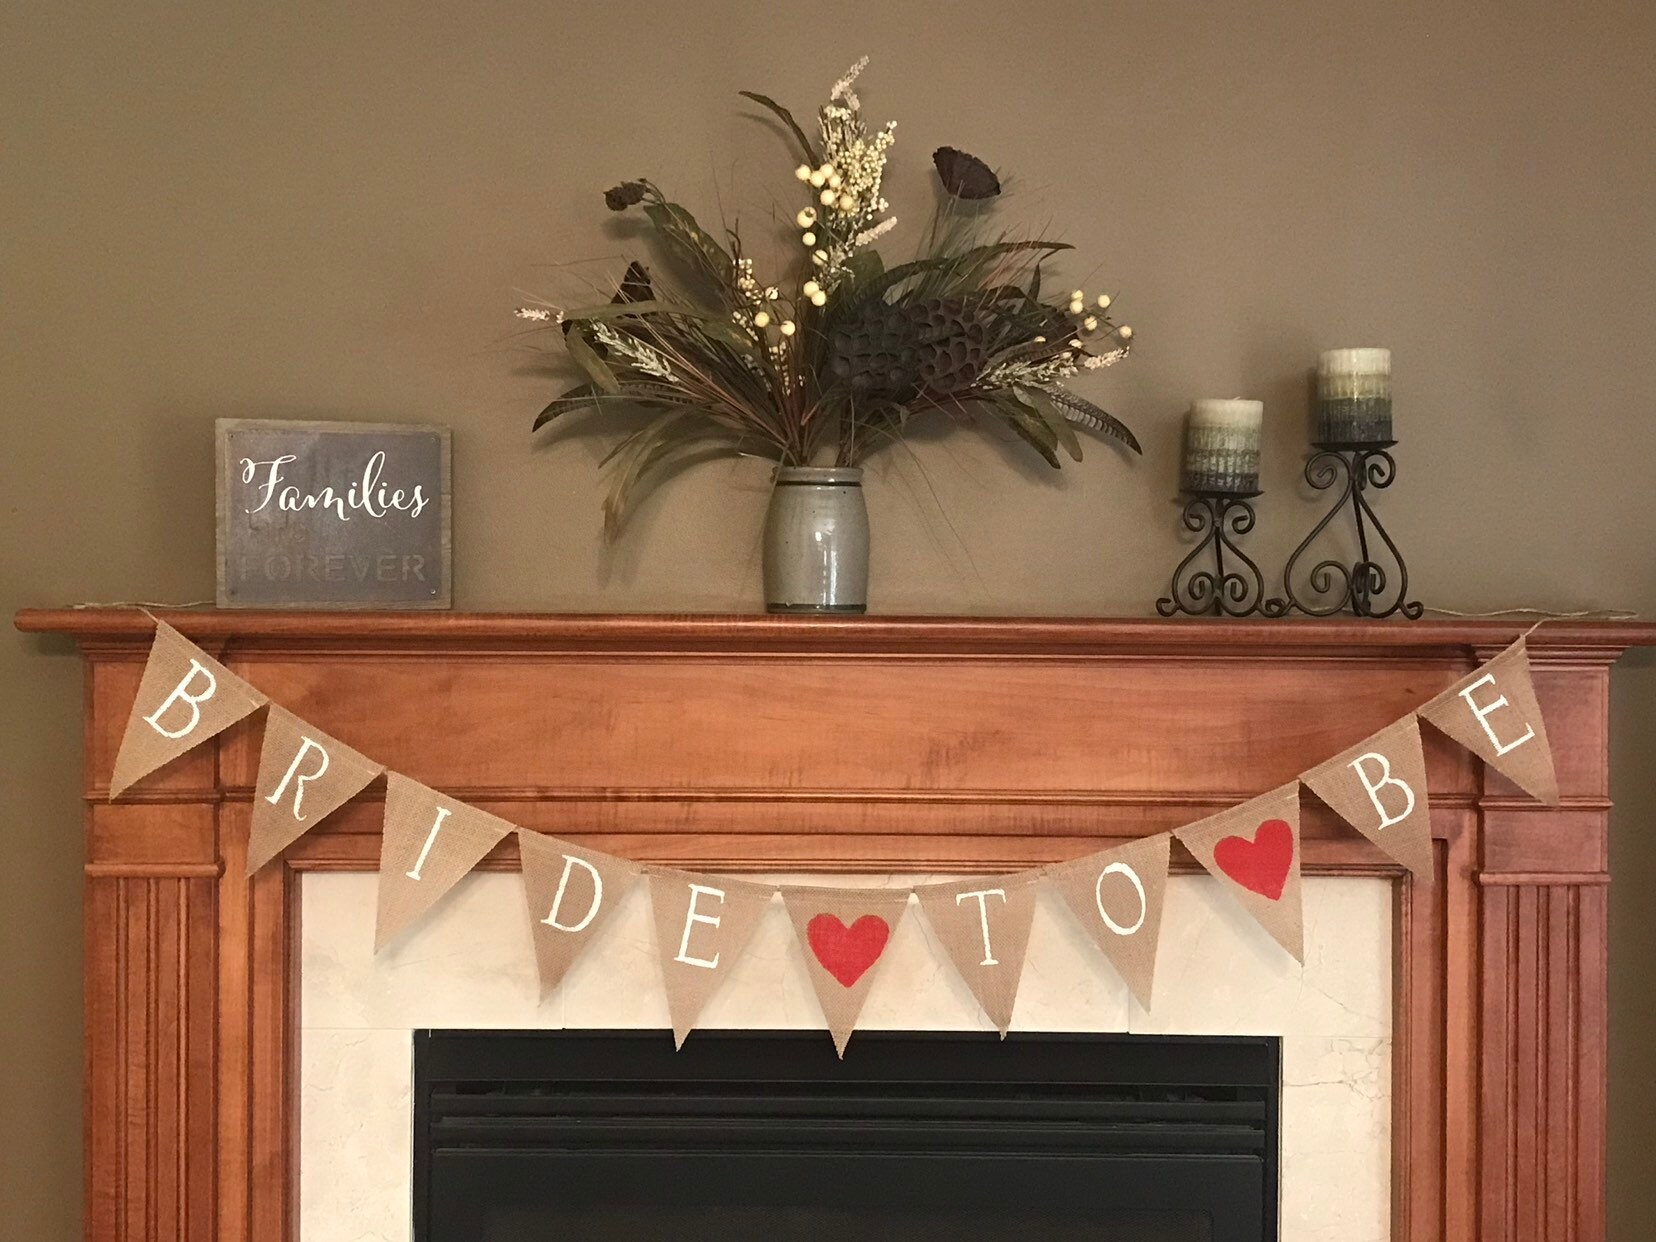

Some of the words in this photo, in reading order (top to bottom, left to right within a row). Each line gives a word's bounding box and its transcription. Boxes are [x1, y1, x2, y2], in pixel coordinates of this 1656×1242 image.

[240, 451, 429, 520] Families
[239, 554, 425, 582] FOREVER
[143, 658, 726, 969] BRIDE
[956, 862, 1146, 967] TO
[1348, 673, 1535, 830] BE
